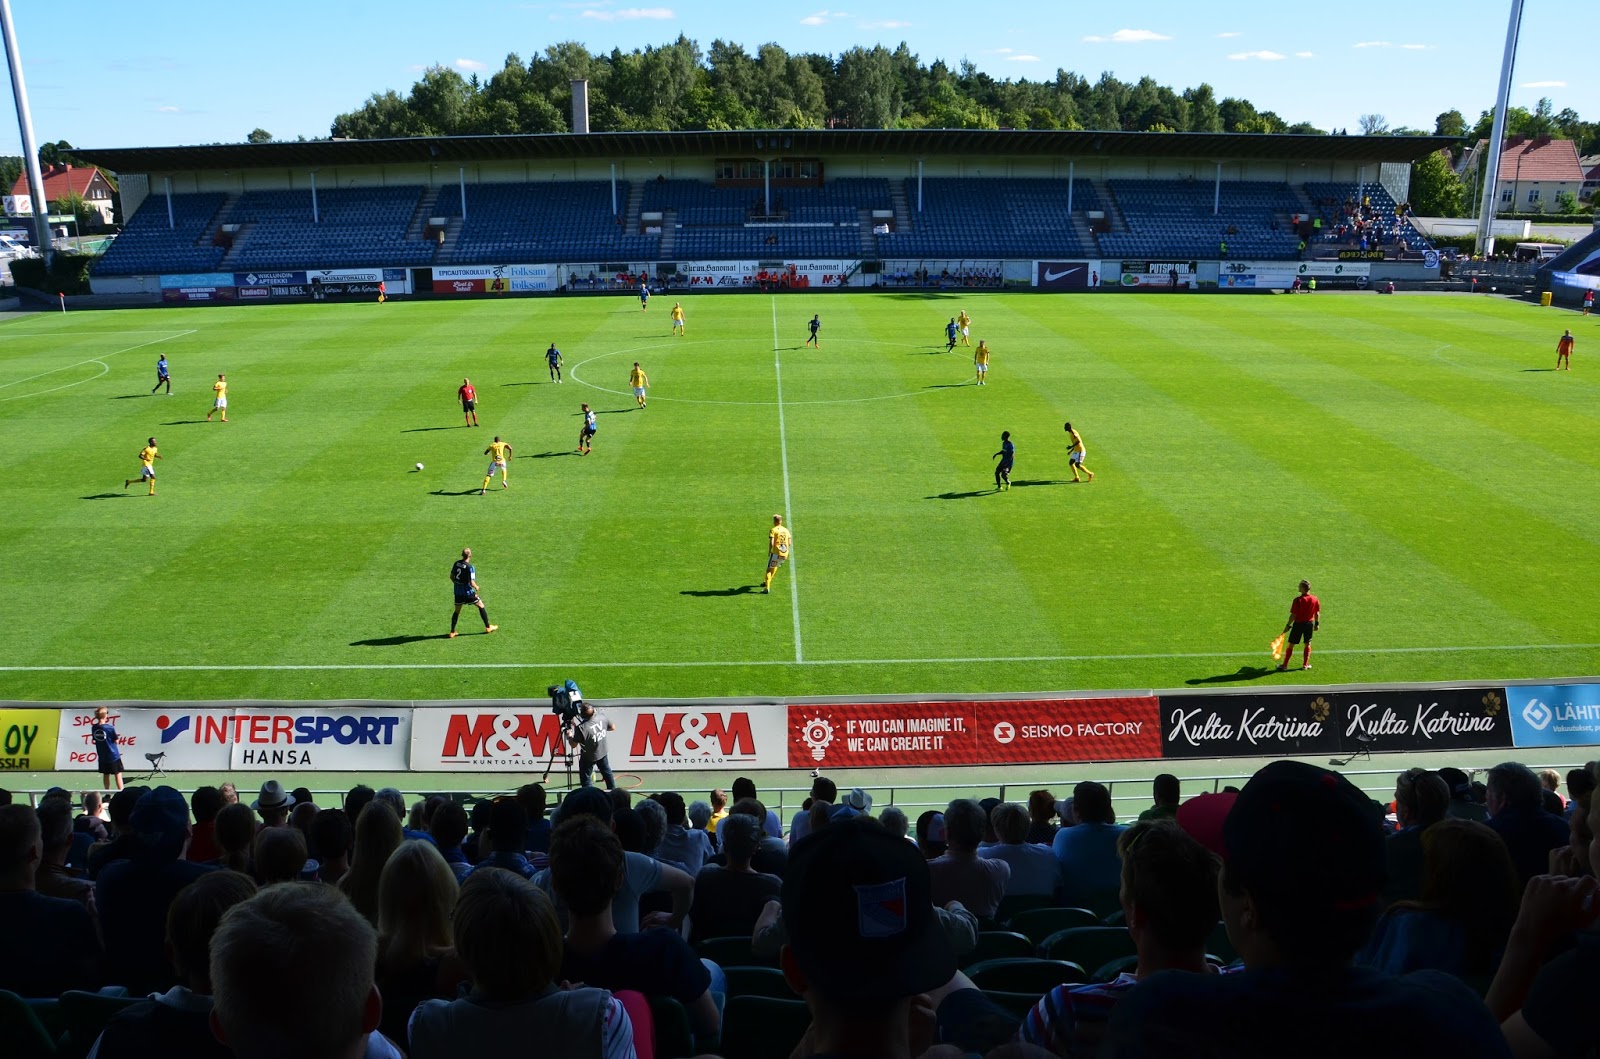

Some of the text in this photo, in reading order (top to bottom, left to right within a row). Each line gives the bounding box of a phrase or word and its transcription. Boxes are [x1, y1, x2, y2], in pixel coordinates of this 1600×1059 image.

[511, 266, 546, 276] Folksam
[704, 264, 736, 272] Sanomat
[786, 263, 807, 271] Trun
[807, 263, 839, 271] Sanomat
[511, 279, 547, 289] Folksam
[691, 275, 713, 285] M&M
[241, 288, 268, 296] RadioCity
[272, 287, 289, 296] TURKU
[455, 568, 462, 580] 2
[73, 715, 120, 727] SPOT
[590, 720, 603, 733] TV
[846, 717, 966, 734] IF YOU CAN IMAGINE IT,
[1168, 707, 1323, 746] Kulta Katriina
[1345, 702, 1495, 741] Kulta Katriina
[194, 715, 399, 745] INTERSPORT
[442, 714, 566, 757] M&M
[629, 712, 757, 757] M&M
[1021, 721, 1143, 738] SEISMO FACTORY
[1552, 725, 1594, 733] Vakuutukset,
[5, 724, 39, 756] OY
[114, 734, 136, 746] HE
[592, 730, 606, 743] 120
[847, 736, 944, 752] WE CAN CREATE IT
[243, 750, 311, 765] HANSA
